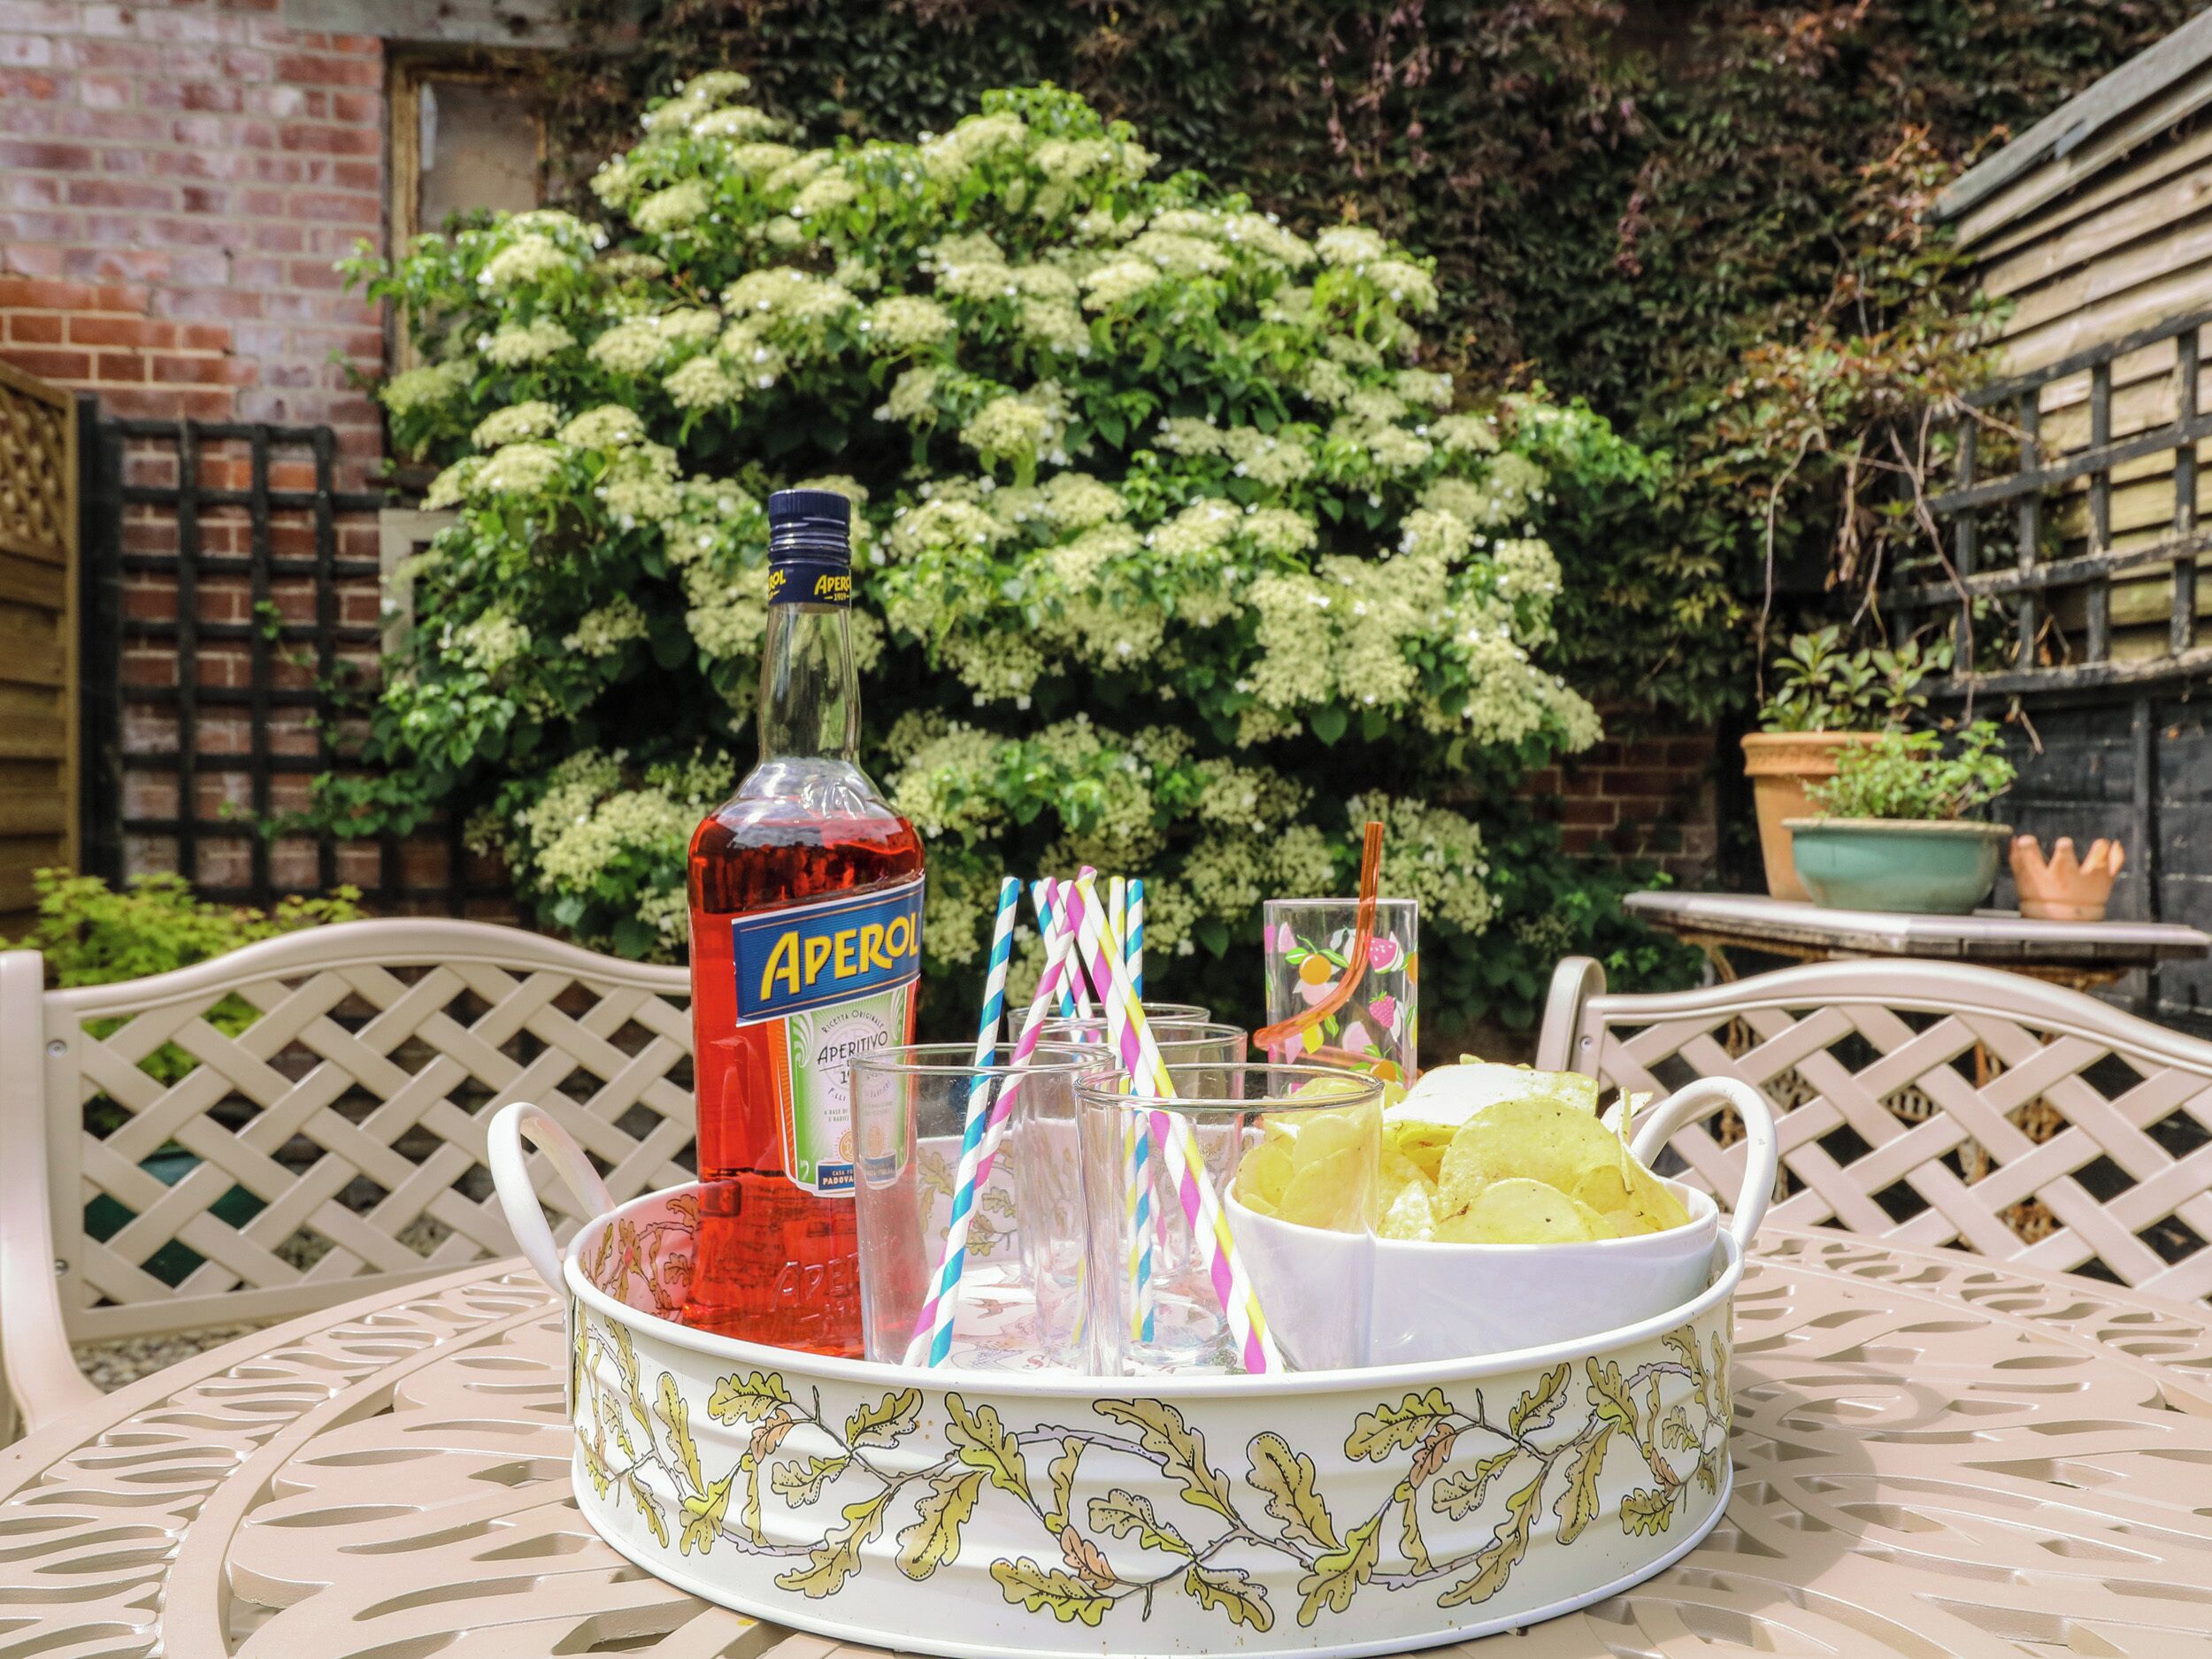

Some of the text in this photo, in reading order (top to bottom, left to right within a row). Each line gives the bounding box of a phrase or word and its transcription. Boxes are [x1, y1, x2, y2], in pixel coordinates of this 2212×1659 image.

[760, 911, 919, 1002] APEROL
[821, 1010, 885, 1034] RICETTA ORIGINALE
[818, 1030, 888, 1065] APERITIVO
[822, 1175, 854, 1186] PADOVA
